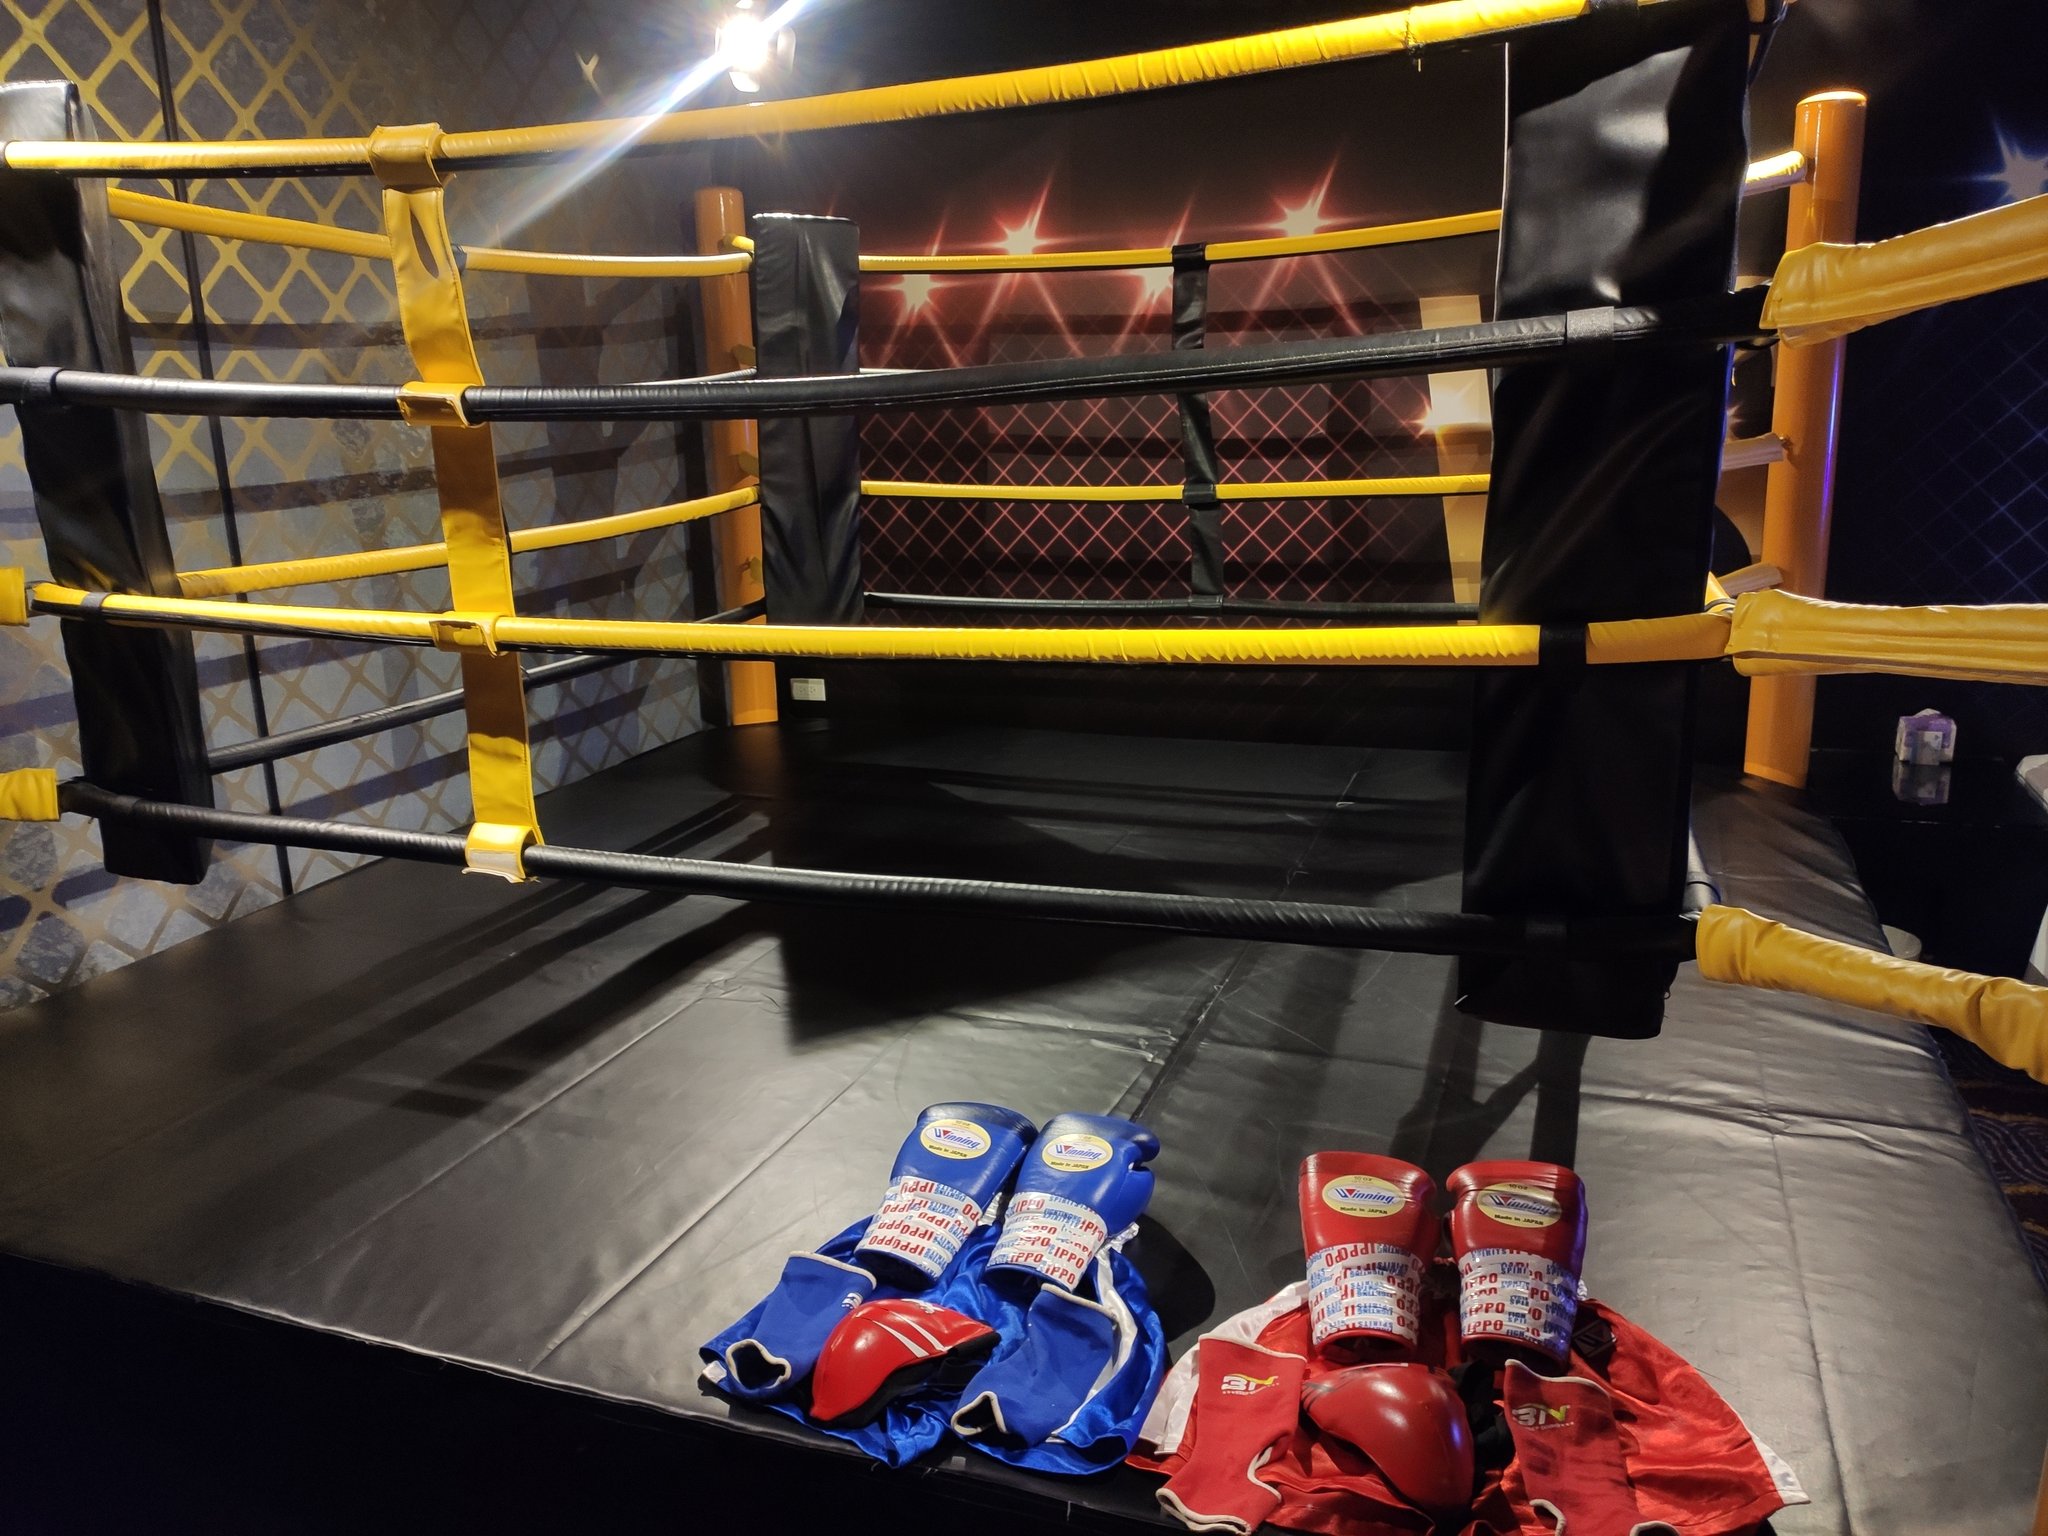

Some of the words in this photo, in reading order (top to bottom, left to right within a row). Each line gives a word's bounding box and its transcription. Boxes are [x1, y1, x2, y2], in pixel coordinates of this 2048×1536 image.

[934, 1128, 981, 1149] Winning
[1055, 1144, 1103, 1160] Winning
[1335, 1187, 1395, 1205] Winning
[900, 1224, 935, 1241] IPPO
[892, 1239, 925, 1256] IPPO
[1053, 1247, 1085, 1269] IPPO
[1045, 1265, 1076, 1285] IPPO
